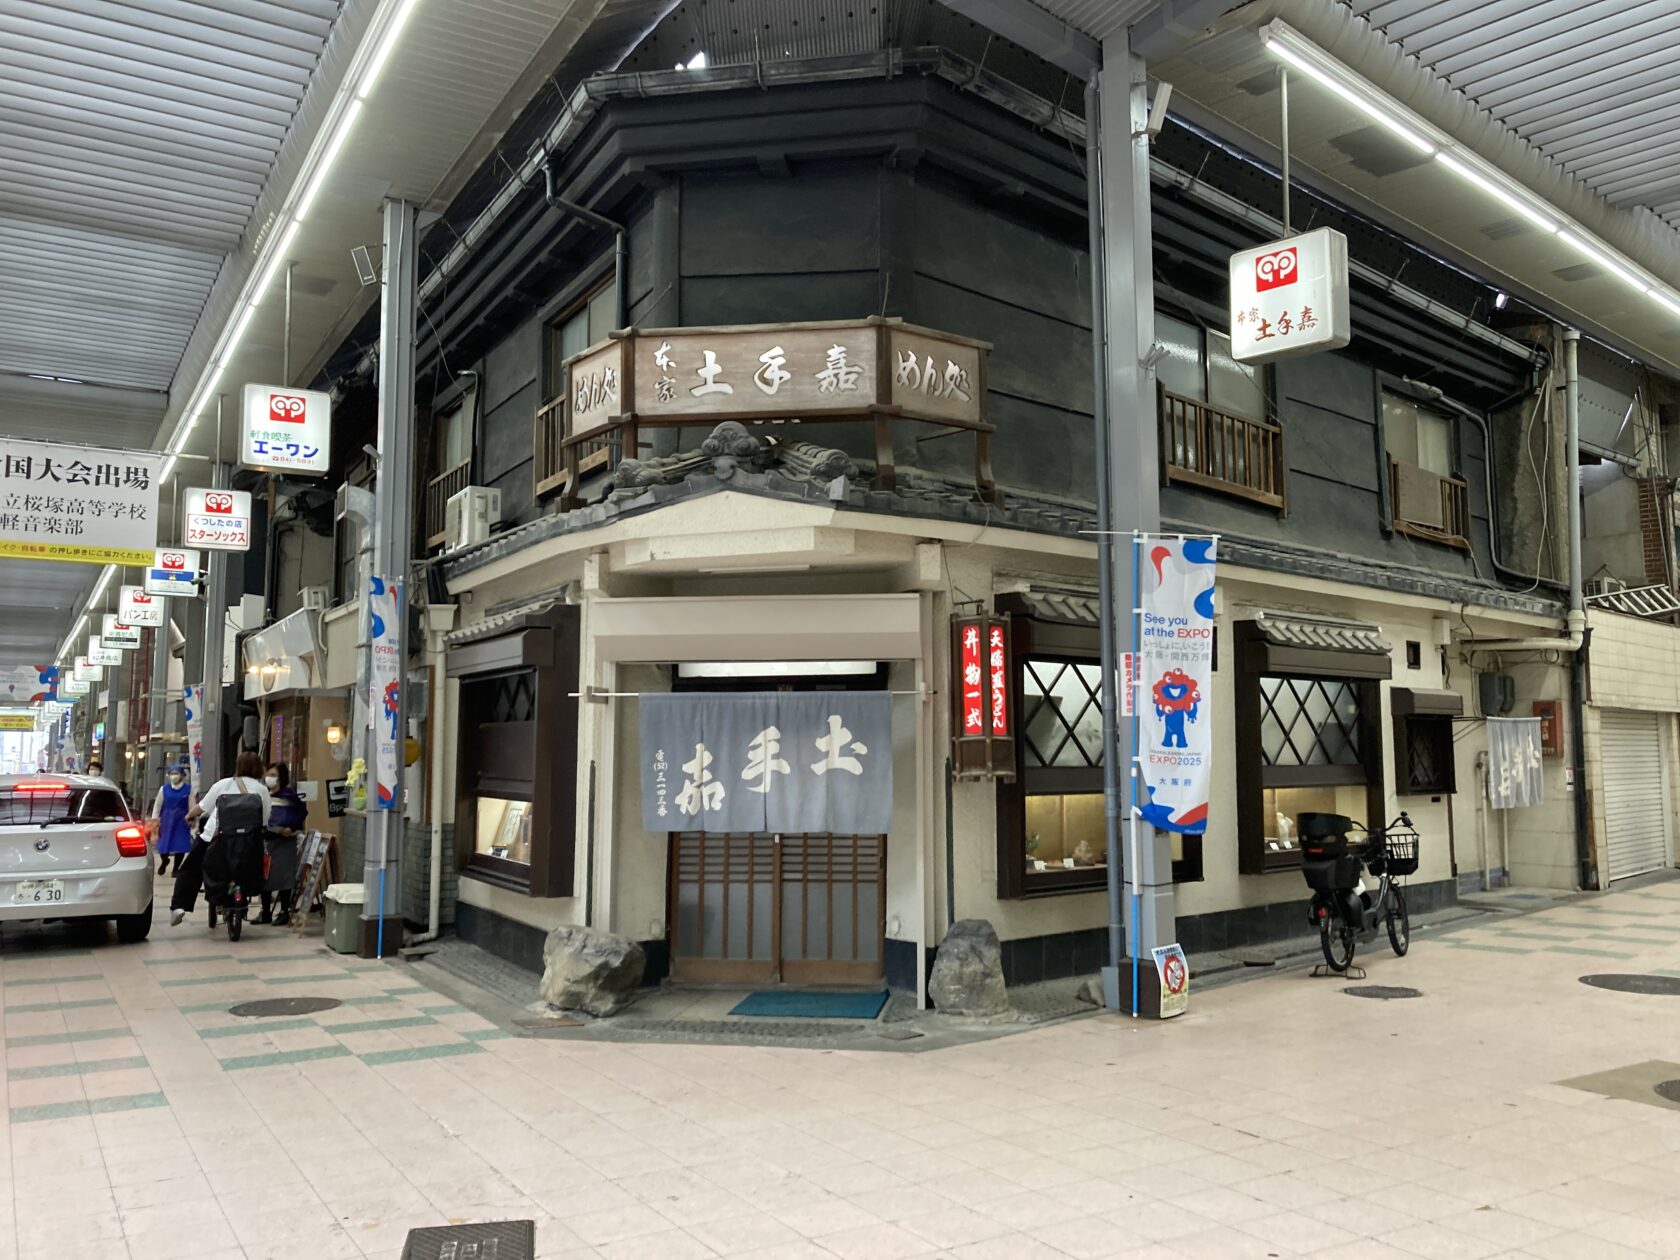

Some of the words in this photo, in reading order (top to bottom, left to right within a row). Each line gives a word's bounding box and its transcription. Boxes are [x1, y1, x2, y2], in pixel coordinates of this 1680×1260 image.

[1255, 305, 1319, 341] 土手嘉
[690, 343, 864, 397] 土手嘉
[896, 350, 972, 401] めん処
[575, 366, 618, 414] めん処
[253, 440, 319, 458] エーワン
[0, 454, 151, 491] 国大会出場
[193, 517, 243, 529] くつしたの店
[189, 529, 246, 543] スターソックス
[1144, 612, 1166, 625] See
[1168, 615, 1188, 626] you
[1144, 628, 1155, 636] at
[1157, 628, 1175, 638] the
[1177, 628, 1210, 639] EXPO
[675, 714, 868, 816] 土手嘉
[1150, 755, 1202, 766] EXPO2025
[1159, 778, 1192, 786] 大阪府
